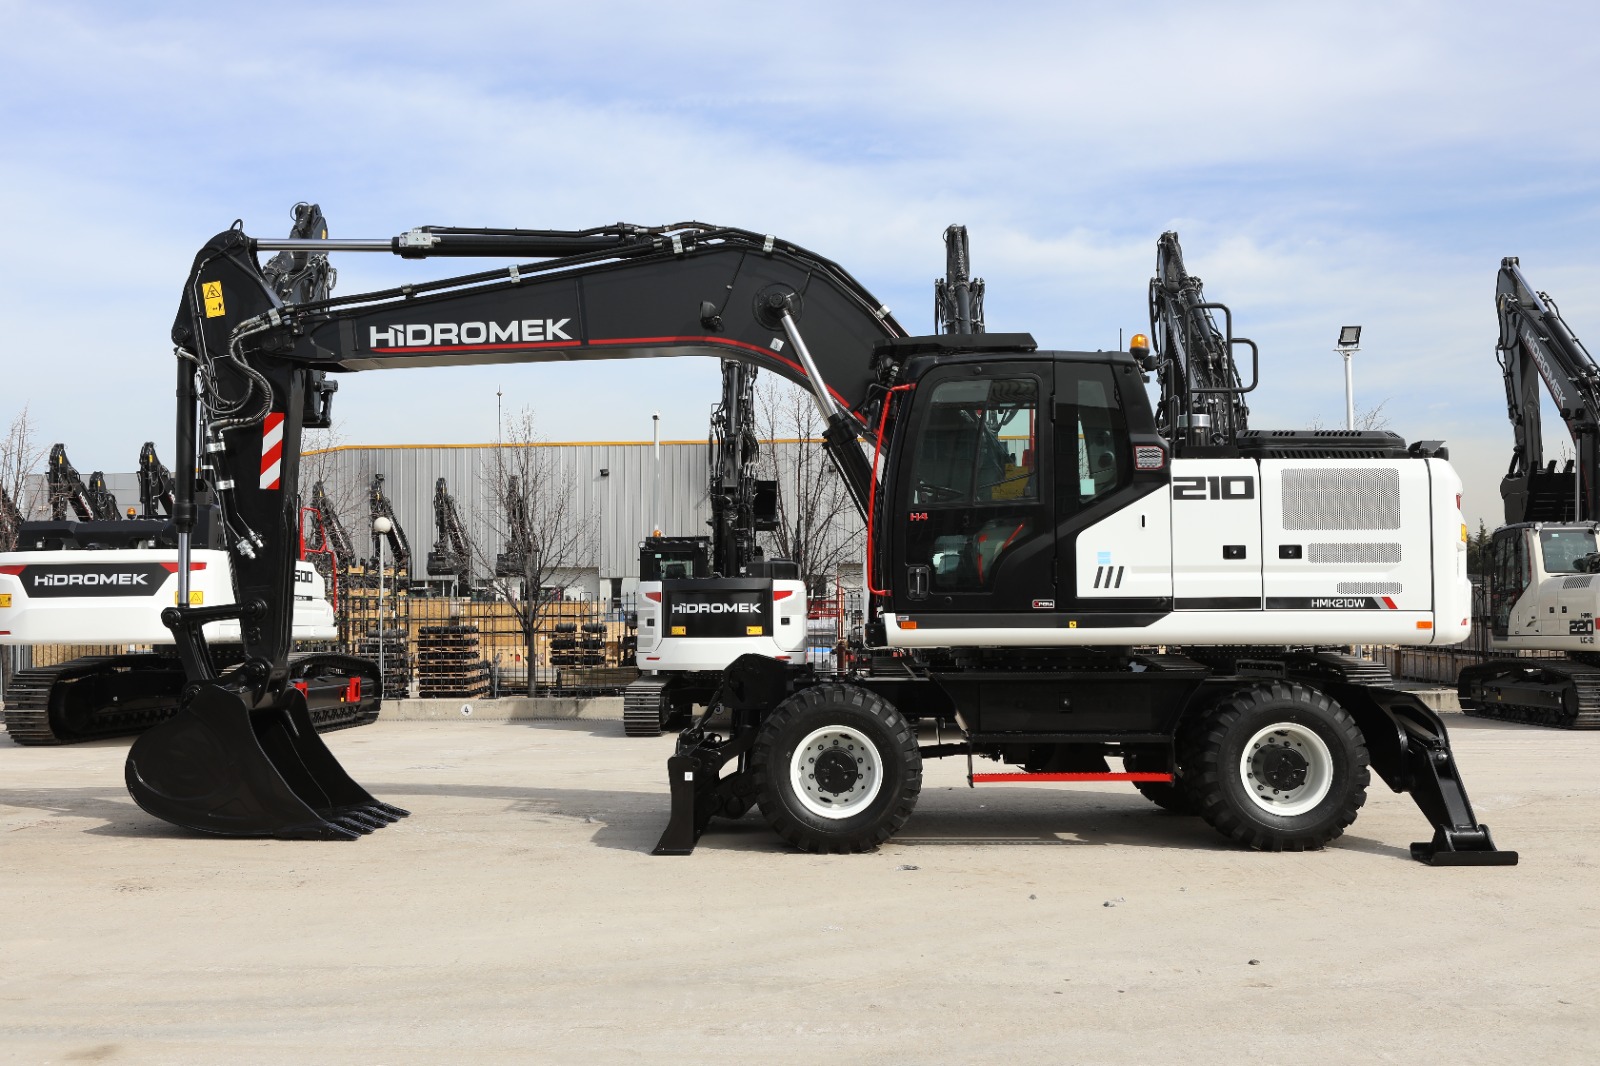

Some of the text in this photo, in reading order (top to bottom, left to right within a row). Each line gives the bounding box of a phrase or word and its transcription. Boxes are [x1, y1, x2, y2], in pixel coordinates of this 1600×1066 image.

[1172, 475, 1255, 501] 210
[1311, 598, 1366, 608] HMK210W
[1569, 620, 1594, 635] 220
